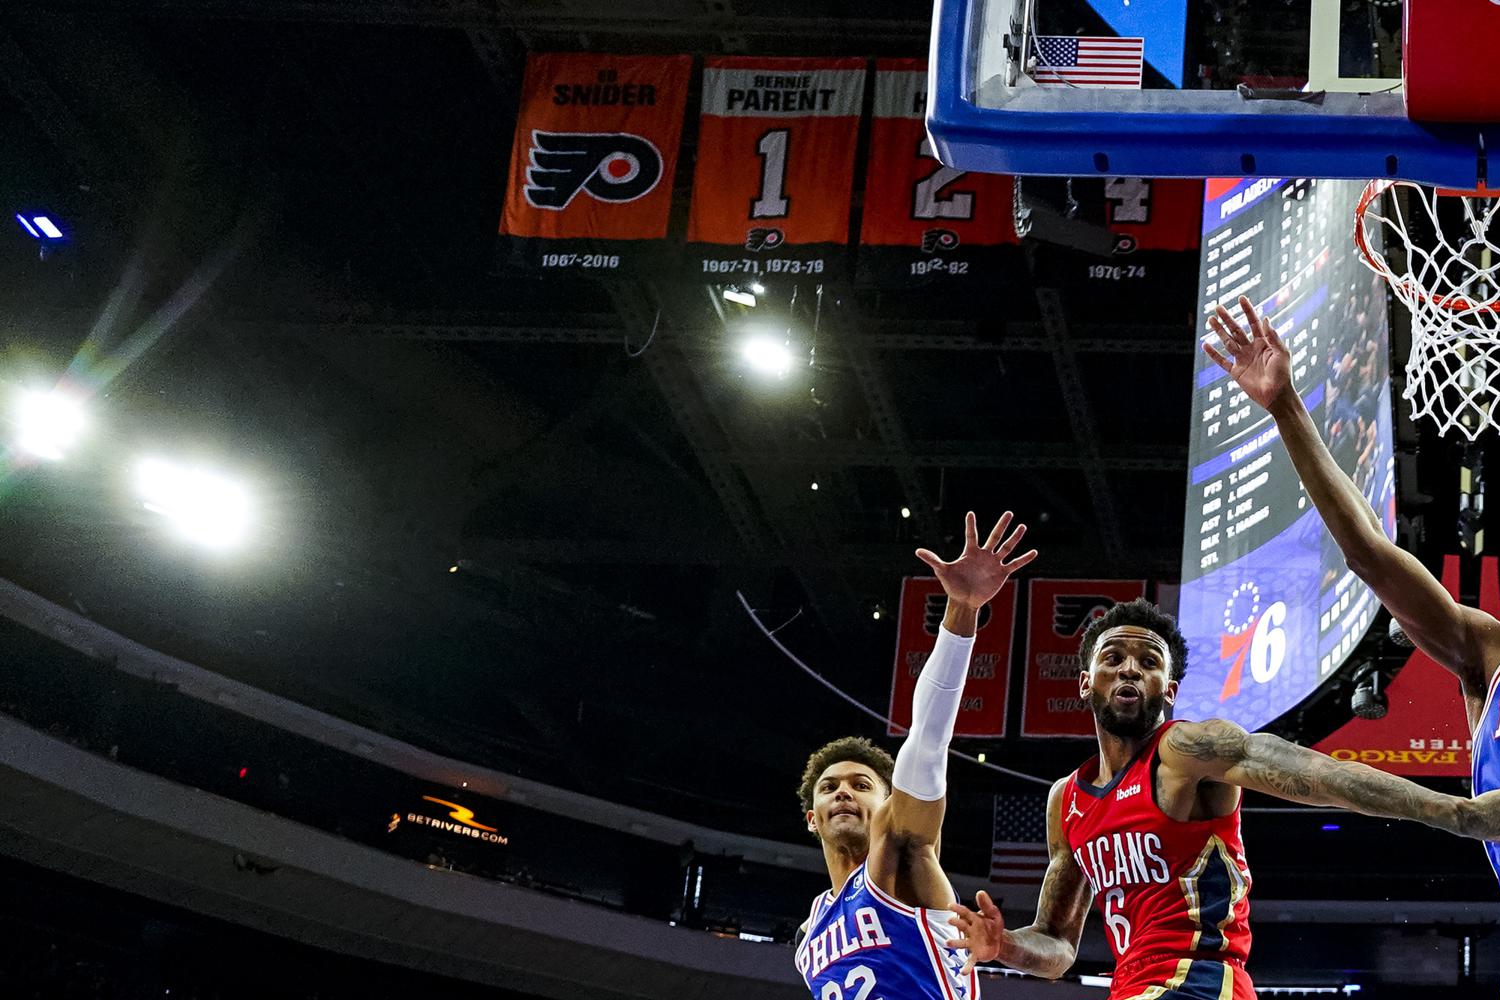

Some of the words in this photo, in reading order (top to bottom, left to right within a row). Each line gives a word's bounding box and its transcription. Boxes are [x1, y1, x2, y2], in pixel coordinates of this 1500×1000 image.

[553, 84, 657, 107] SNIDER
[754, 75, 812, 89] BERNIE
[727, 89, 835, 112] PARENT
[751, 128, 790, 219] 1
[1219, 600, 1287, 704] 76
[1330, 749, 1458, 764] FARGO
[407, 812, 508, 846] BETRIVERS.COM
[1104, 886, 1131, 956] 6
[799, 906, 893, 979] PHILA
